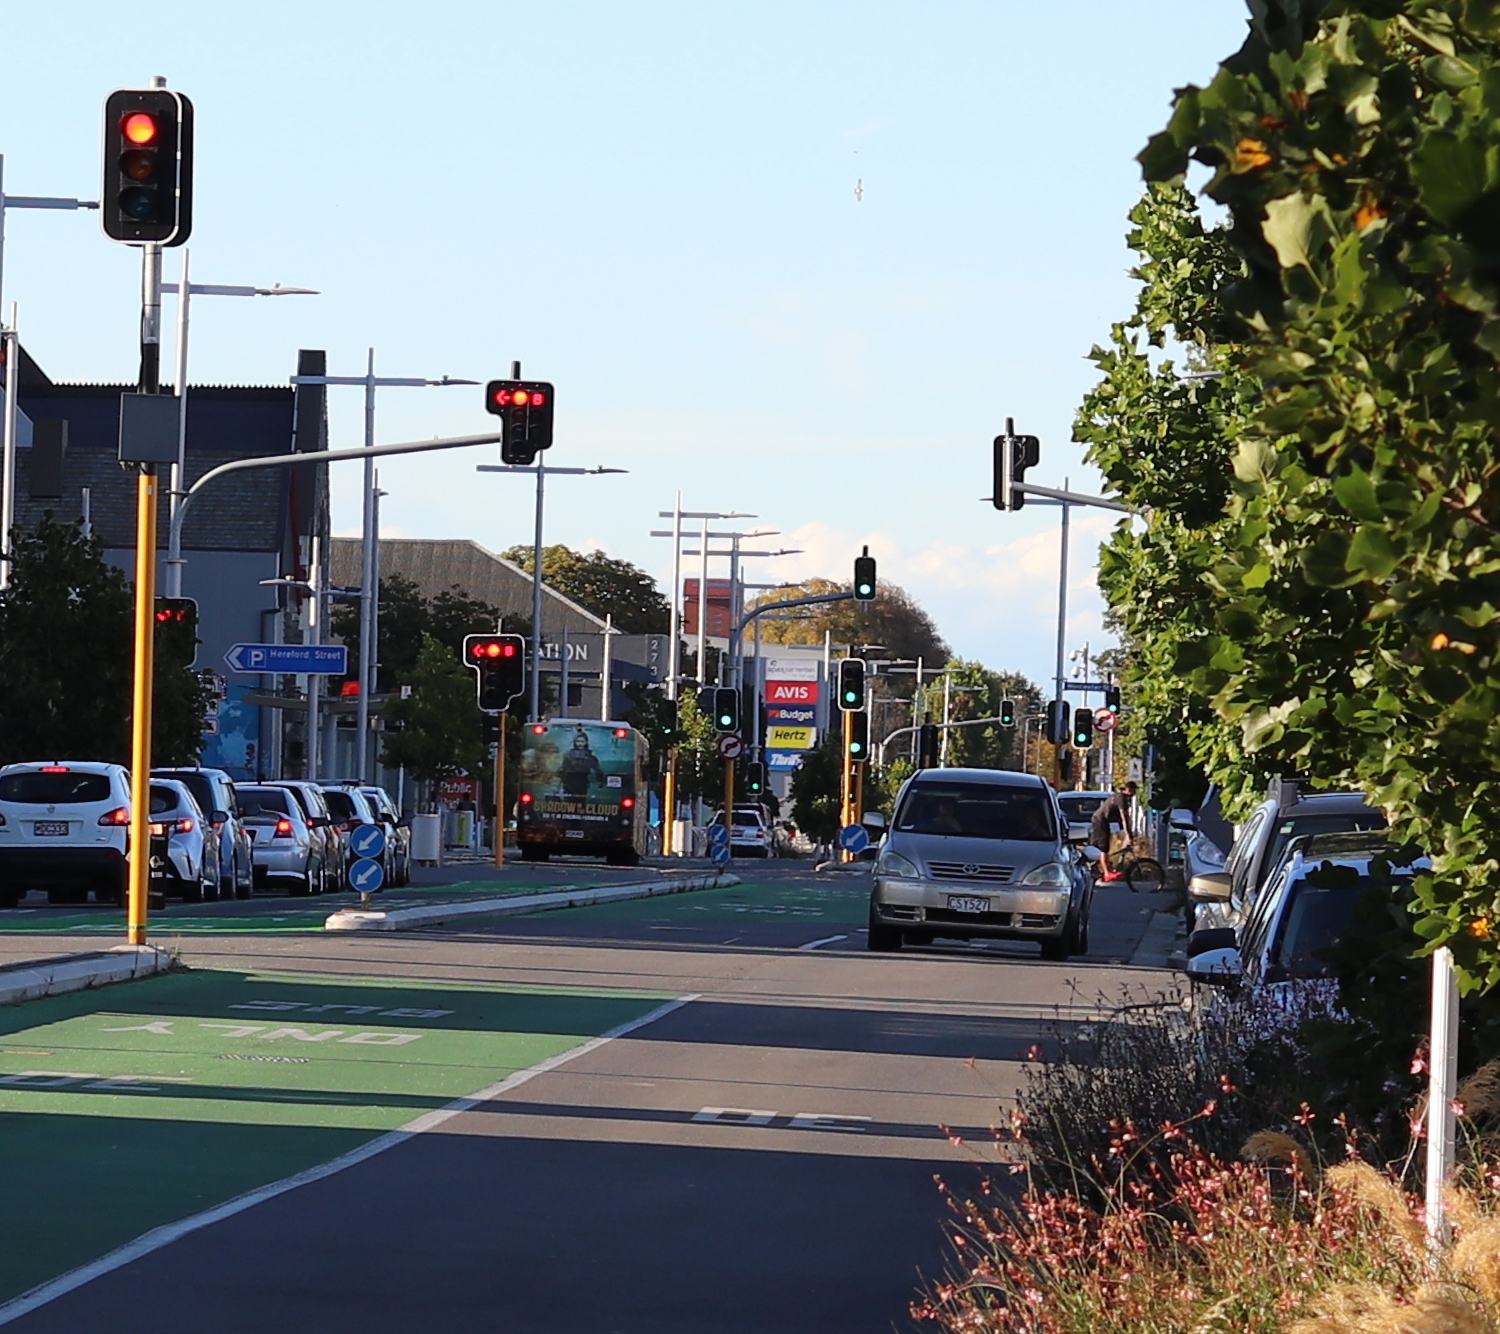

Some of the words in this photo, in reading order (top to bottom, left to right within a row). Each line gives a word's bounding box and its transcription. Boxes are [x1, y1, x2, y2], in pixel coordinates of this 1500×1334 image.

[251, 650, 263, 666] P
[270, 650, 309, 659] Hereford
[315, 651, 341, 660] Street
[774, 686, 809, 699] AVIS
[780, 709, 813, 721] Budget
[775, 730, 806, 740] Hertz
[440, 781, 471, 793] Public
[534, 801, 576, 814] SHADOW
[586, 803, 619, 816] CLOUD
[950, 898, 988, 911] CSY527
[227, 1000, 456, 1018] BUS
[103, 1022, 423, 1046] ONLY
